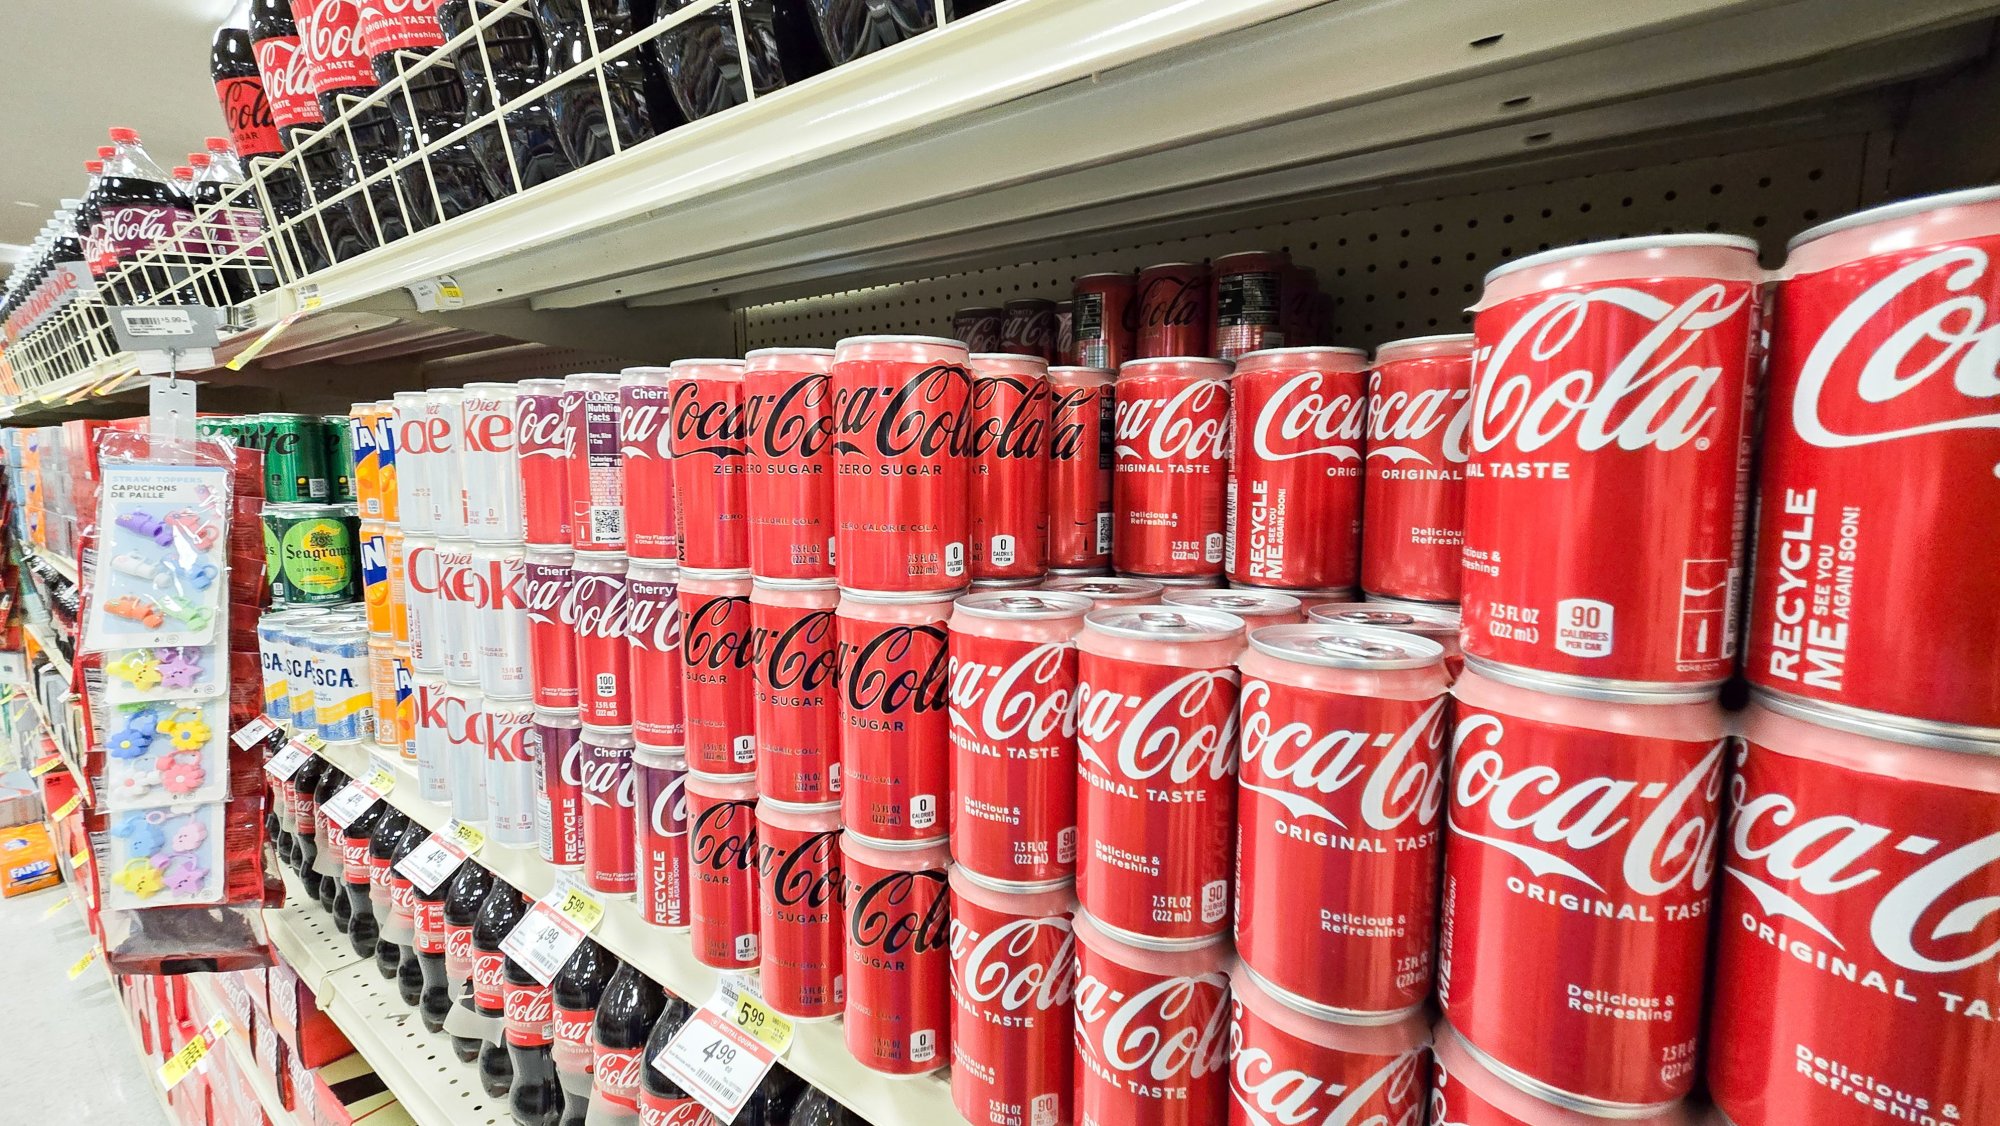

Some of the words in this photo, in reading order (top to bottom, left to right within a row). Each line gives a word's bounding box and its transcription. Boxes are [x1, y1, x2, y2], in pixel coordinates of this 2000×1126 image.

[404, 15, 439, 25] TASTE
[631, 388, 669, 400] Cherr
[466, 398, 501, 412] Diet
[464, 413, 515, 453] ke
[713, 464, 744, 475] ZER
[767, 464, 823, 475] SUGAR
[838, 464, 872, 475] ZERO
[880, 464, 943, 476] SUGAR
[1168, 464, 1210, 474] TASTE
[1381, 469, 1464, 481] ORIGINAL
[1490, 462, 1570, 479] TASTE
[112, 484, 177, 492] CAPUCHONS
[1278, 488, 1286, 517] SOON!
[792, 518, 820, 526] COLA
[1130, 511, 1169, 519] Delicious
[1130, 518, 1177, 527] Refreshing
[862, 524, 906, 533] CALORIE
[910, 524, 938, 532] COLA
[1250, 480, 1268, 578] RECYCLE
[1268, 528, 1276, 543] SEE
[1277, 517, 1285, 543] AGAIN
[1837, 506, 1861, 558] SOON!
[1000, 538, 1007, 551] 0
[1210, 536, 1221, 549] 90
[1412, 536, 1464, 545] Refreshi
[953, 546, 959, 559] 0
[1492, 550, 1501, 562] &
[1266, 544, 1284, 579] ME
[1817, 544, 1835, 582] YOU
[537, 566, 570, 577] Cherr
[632, 582, 675, 595] Cherry
[1769, 487, 1818, 681] RECYCLE
[1832, 560, 1854, 621] AGAIN
[1812, 583, 1831, 616] SEE
[1490, 602, 1506, 620] 7.5
[1507, 605, 1520, 622] FL
[1522, 608, 1539, 625] OZ
[1571, 605, 1600, 629] 90
[1489, 620, 1512, 640] (222
[1513, 625, 1539, 644] mL)
[1560, 627, 1609, 642] CALORIES
[1565, 640, 1583, 651] PER
[1584, 641, 1602, 651] CAN
[1801, 617, 1849, 692] ME
[599, 676, 613, 685] 100
[686, 671, 728, 683] SUGAR
[771, 695, 824, 707] SUGAR
[851, 718, 904, 732] SUGAR
[486, 726, 536, 763] ke
[742, 738, 749, 749] 0
[1007, 746, 1060, 760] TASTE
[1147, 789, 1206, 803] TASTE
[919, 798, 927, 812] 0
[964, 795, 1009, 815] Delicious
[1012, 806, 1020, 815] &
[965, 804, 1019, 826] Refreshing
[561, 798, 576, 862] RECYCLE
[1274, 818, 1388, 854] ORIGINAL
[1014, 841, 1026, 852] 7.5
[1027, 841, 1036, 853] FL
[1037, 841, 1048, 852] OZ
[1095, 839, 1147, 864] Delicious
[1152, 855, 1160, 866] &
[1014, 853, 1032, 865] (222
[1095, 849, 1159, 877] Refreshing
[10, 861, 52, 879] FANTA
[654, 850, 667, 923] RECYCLE
[1209, 884, 1223, 901] 90
[1152, 895, 1166, 908] 7.5
[1167, 896, 1178, 909] FL
[1180, 896, 1192, 908] OZ
[1506, 875, 1655, 923] ORIGINAL
[667, 899, 681, 925] ME
[777, 911, 829, 924] SUGAR
[1152, 909, 1172, 923] (222
[1174, 910, 1192, 924] mL)
[1320, 908, 1394, 927] Delicious
[1398, 914, 1406, 925] &
[1321, 920, 1405, 938] Refreshing
[744, 937, 750, 949] 0
[854, 949, 905, 971] SUGAR
[1742, 912, 1917, 1003] ORIGINAL
[1567, 983, 1660, 1008] Delicious
[1665, 994, 1674, 1006] &
[1568, 997, 1673, 1022] Refreshing
[984, 1009, 1034, 1028] TASTE
[719, 1023, 738, 1040] DIGITAL
[737, 1034, 759, 1052] COUPON
[919, 1033, 927, 1047] 0
[1796, 1043, 1929, 1112] Delicious
[1942, 1101, 1960, 1120] &
[1128, 1080, 1187, 1100] TASTE
[989, 1099, 1001, 1111] 7.5
[1001, 1100, 1010, 1113] FL
[1011, 1104, 1022, 1114] OZ
